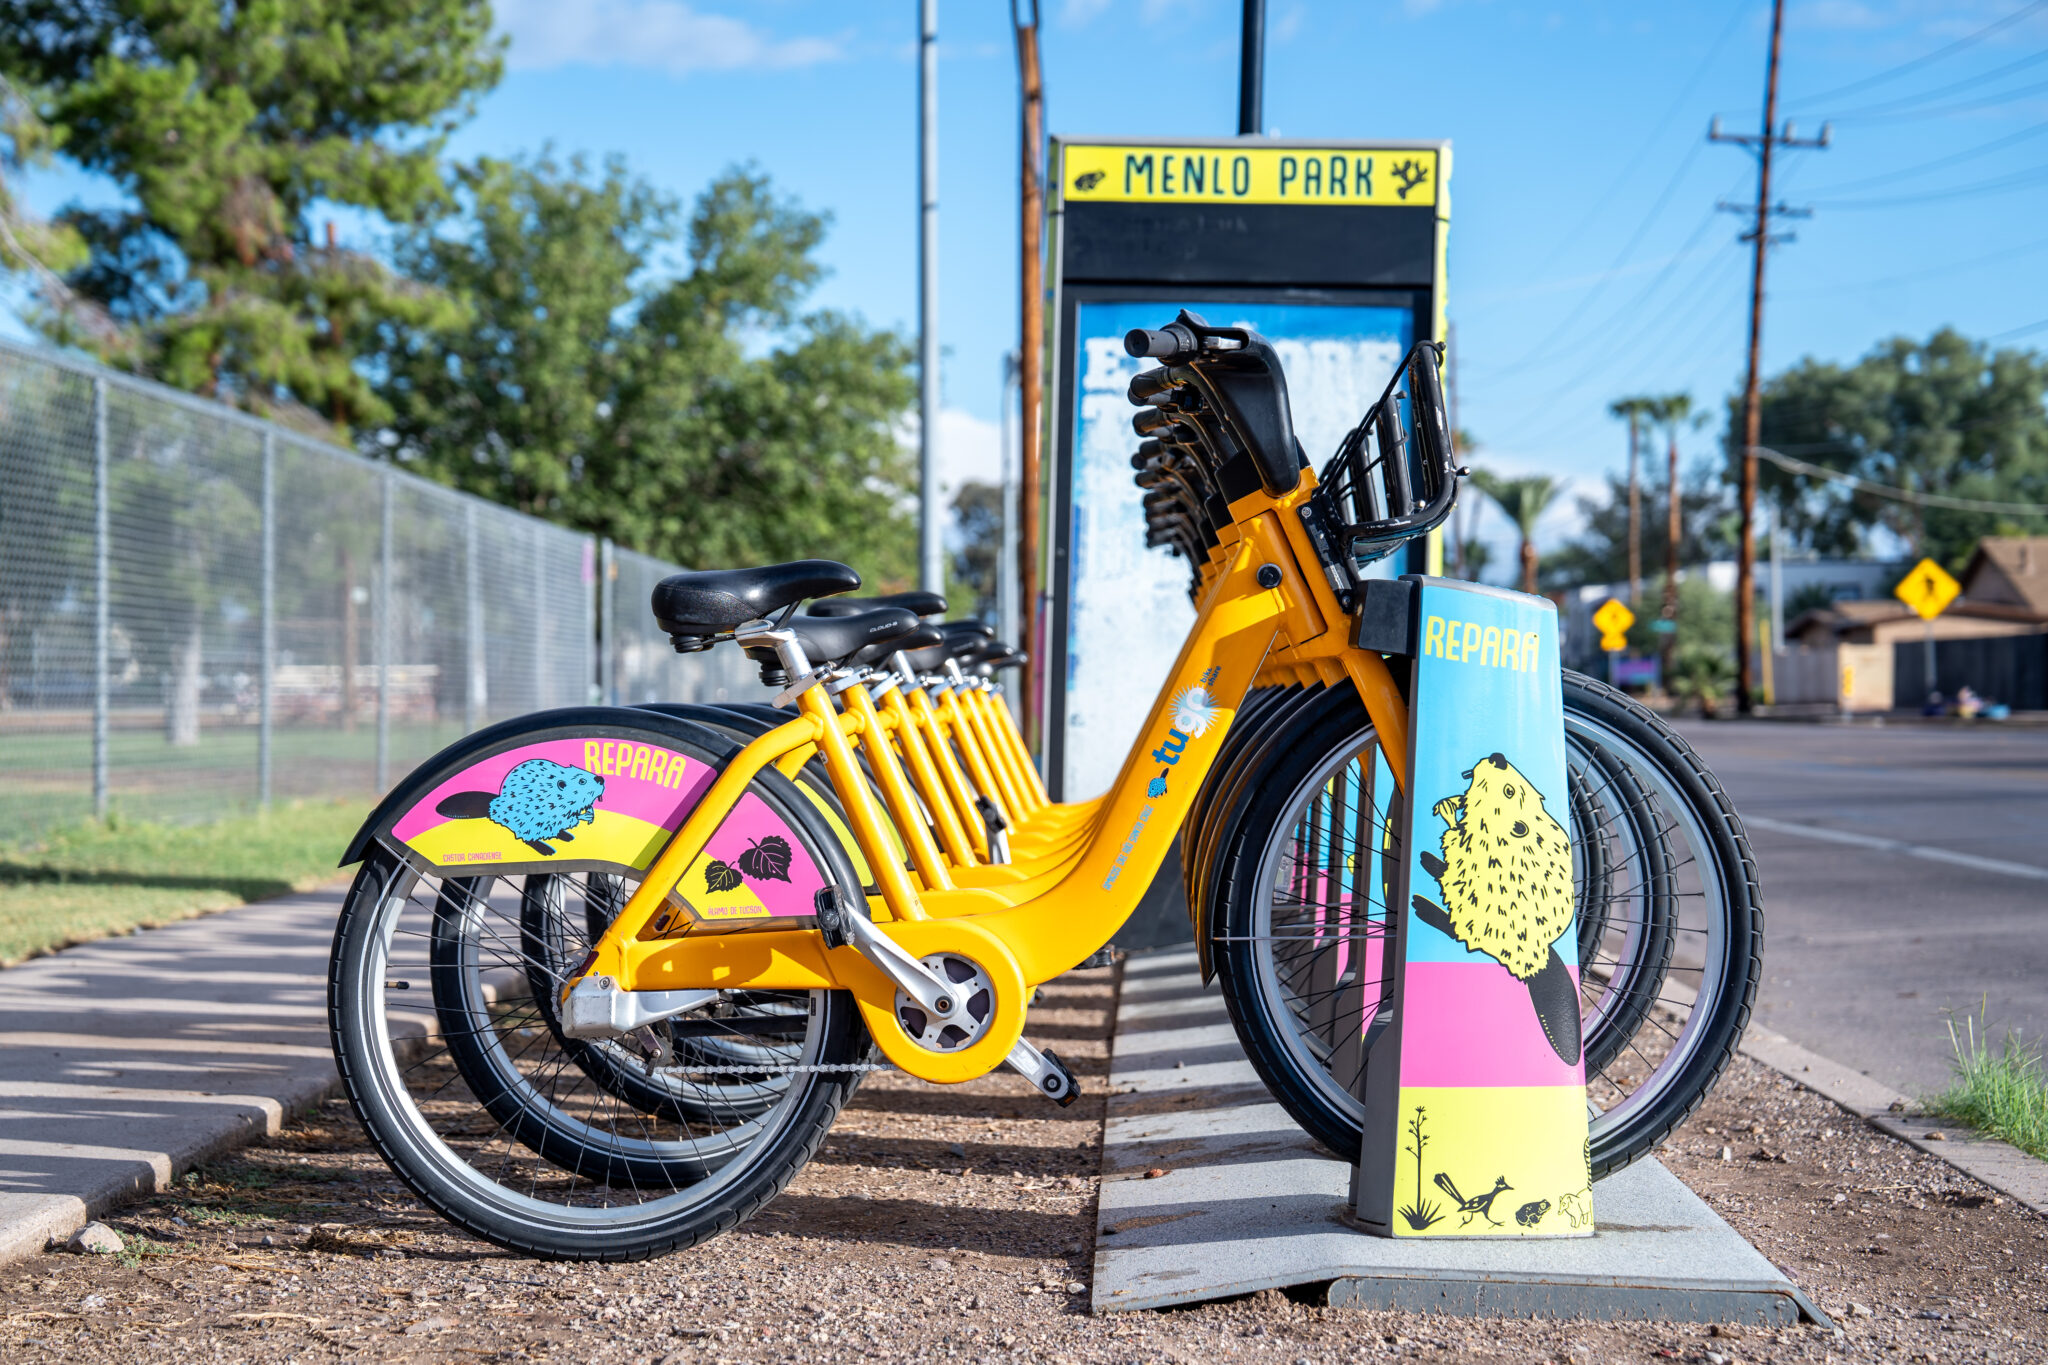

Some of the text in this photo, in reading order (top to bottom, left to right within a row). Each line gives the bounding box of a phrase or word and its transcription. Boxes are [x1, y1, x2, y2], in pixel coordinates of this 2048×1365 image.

[1124, 154, 1374, 197] MENLO PARK
[1424, 615, 1541, 673] REPARA
[1200, 667, 1213, 684] bike
[1207, 665, 1222, 686] share
[1151, 686, 1210, 766] tugo
[584, 740, 687, 790] REPARA
[442, 851, 503, 863] CASTOR CANADIENSE
[1103, 865, 1121, 891] AMIGOS
[1115, 853, 1128, 866] DEL
[1128, 821, 1145, 843] SANTA
[1139, 804, 1154, 822] CRUZ
[730, 906, 738, 915] DE
[739, 904, 763, 915] TUCSON
